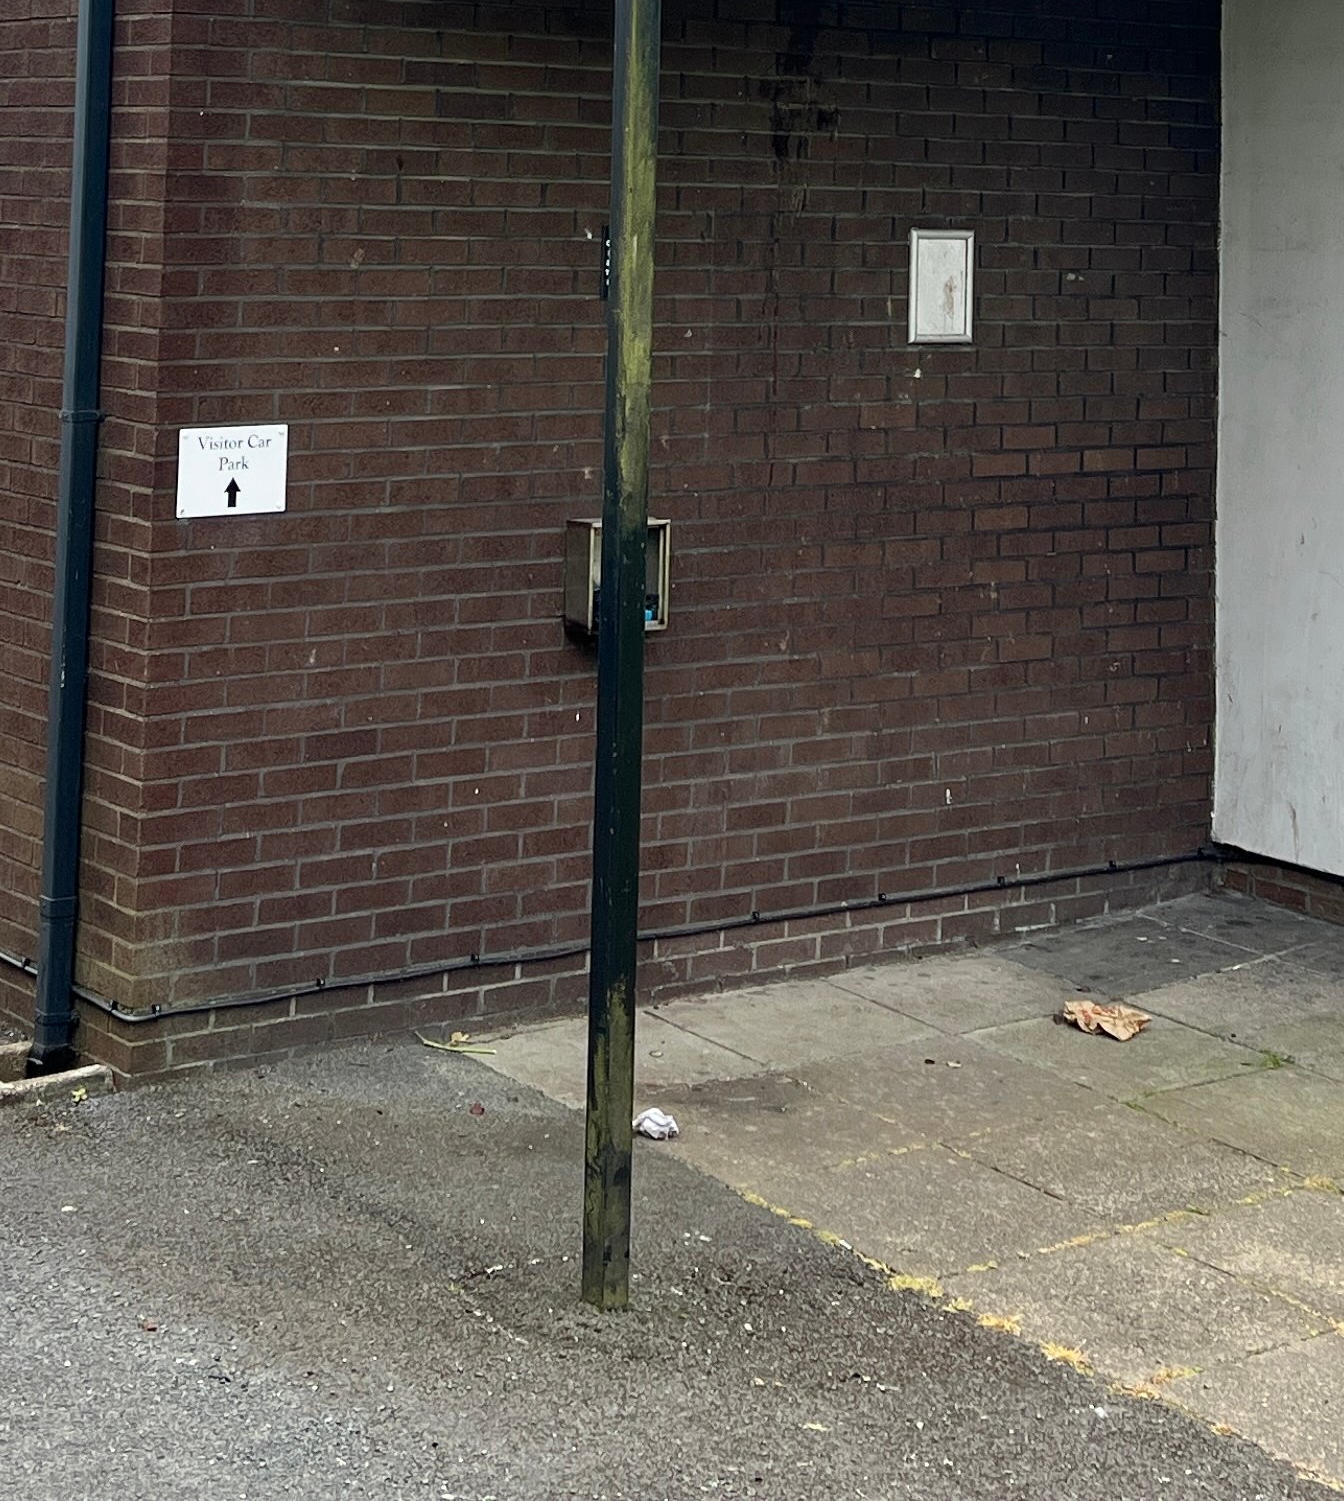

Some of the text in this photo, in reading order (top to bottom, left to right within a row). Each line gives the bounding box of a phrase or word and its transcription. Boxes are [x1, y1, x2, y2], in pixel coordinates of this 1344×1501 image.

[198, 434, 272, 450] Visitor Car
[218, 456, 249, 471] Park
